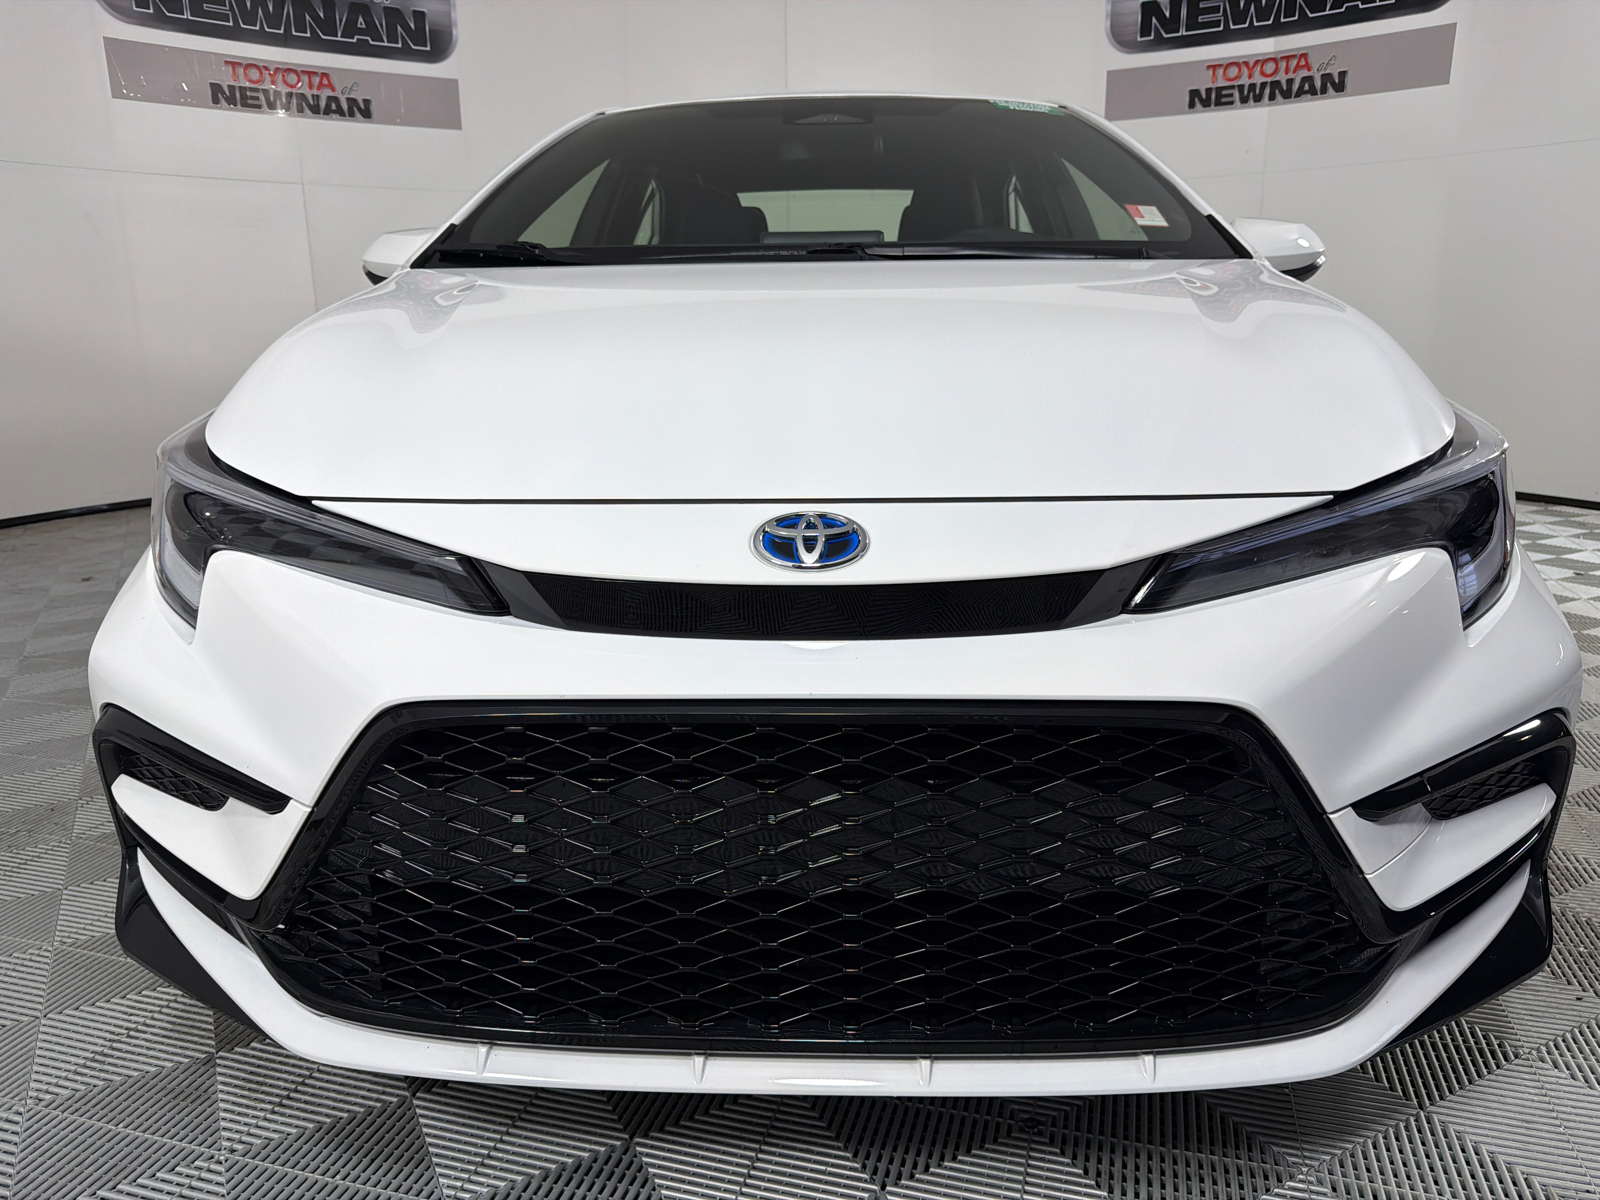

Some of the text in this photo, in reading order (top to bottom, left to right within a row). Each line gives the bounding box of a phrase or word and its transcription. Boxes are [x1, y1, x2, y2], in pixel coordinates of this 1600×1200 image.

[224, 59, 337, 93] TOYOTA
[1206, 51, 1337, 84] TOYOTA of
[209, 81, 372, 119] NEWNAN
[1188, 69, 1348, 110] NEWNAN
